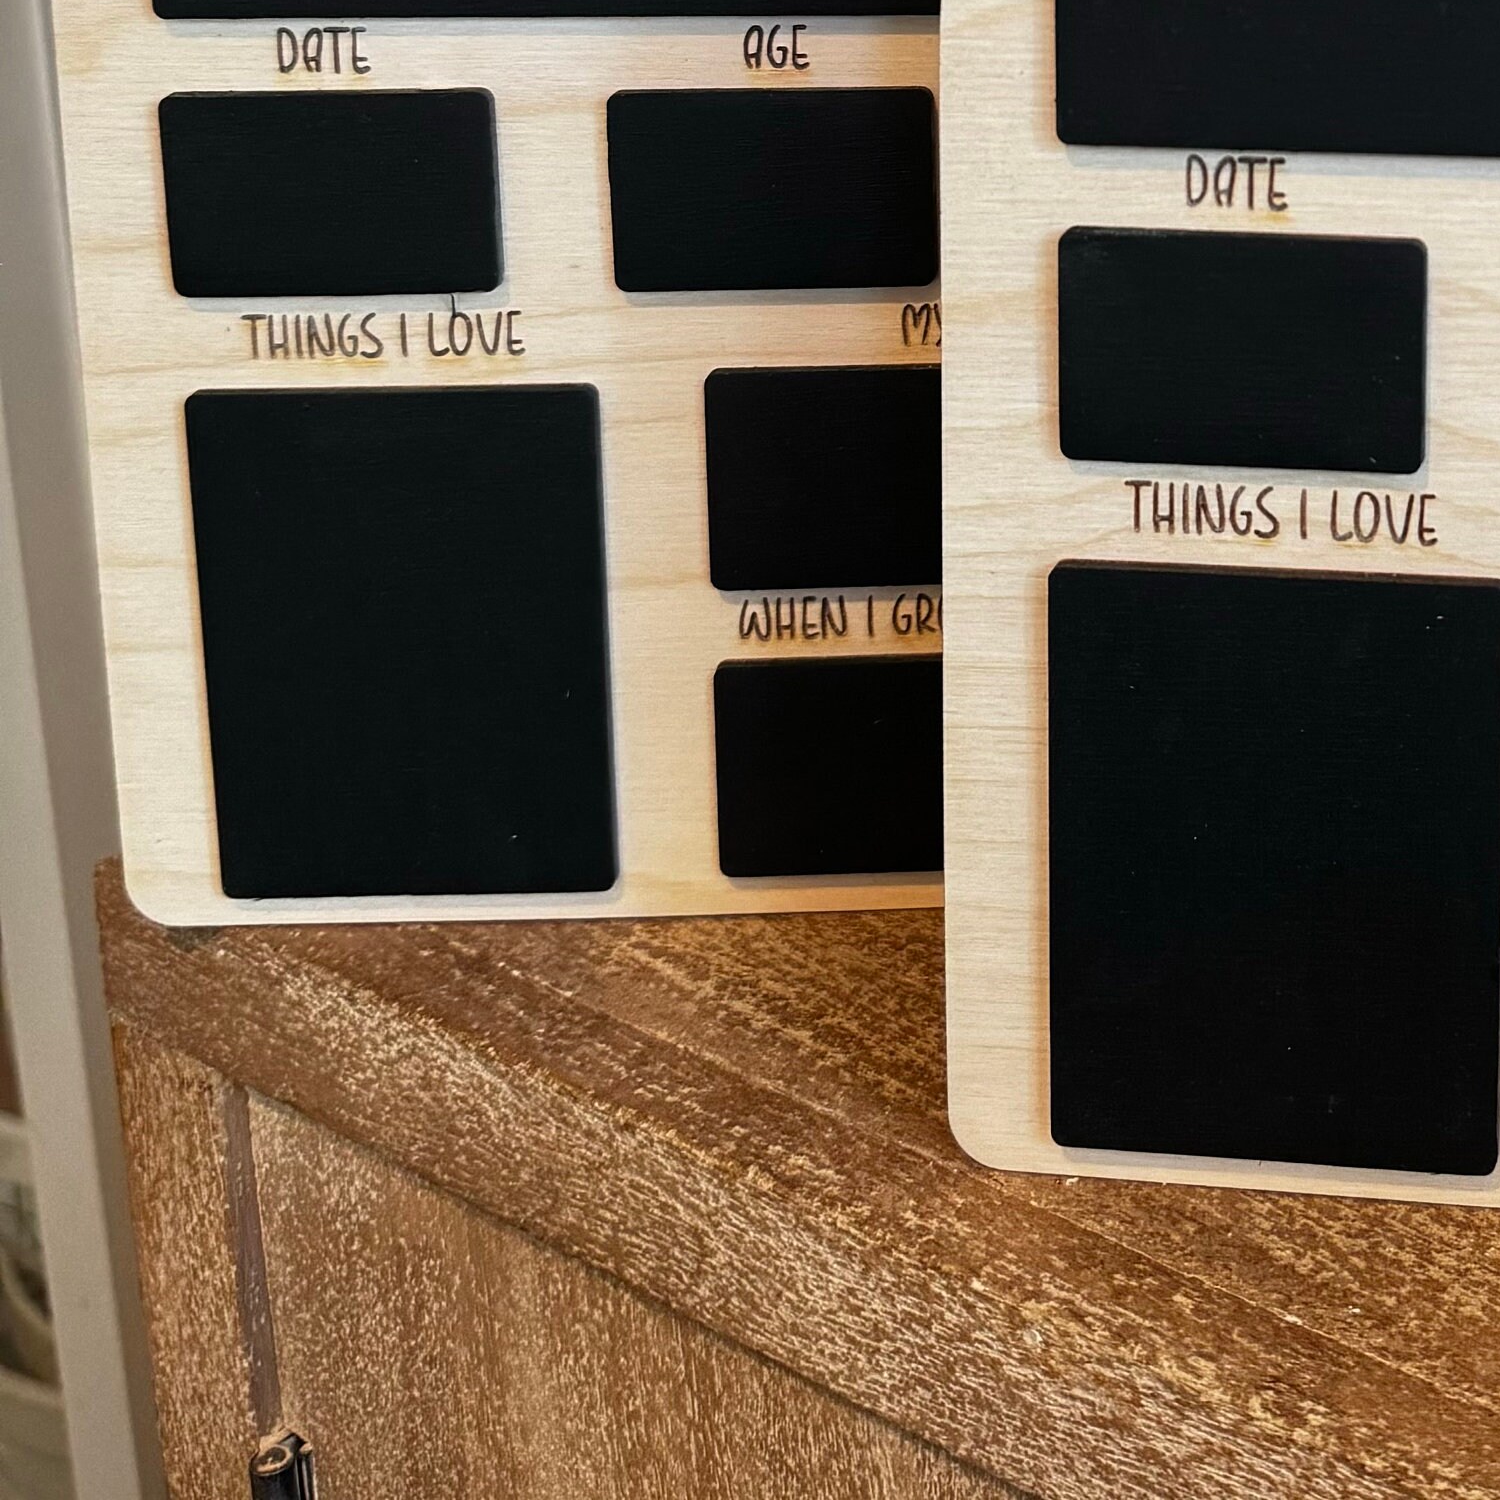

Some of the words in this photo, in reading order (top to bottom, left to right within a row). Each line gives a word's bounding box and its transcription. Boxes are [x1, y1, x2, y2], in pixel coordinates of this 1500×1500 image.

[276, 25, 373, 76] DATE
[743, 23, 812, 71] AGE
[1184, 153, 1289, 213] DATE
[241, 312, 383, 360] THINGS
[400, 312, 409, 358] I
[427, 310, 527, 358] LOVE
[1124, 478, 1281, 540] THINGS
[1299, 486, 1308, 540] I
[1330, 489, 1439, 547] LOVE
[738, 594, 849, 642] WHEN
[867, 594, 875, 638] I
